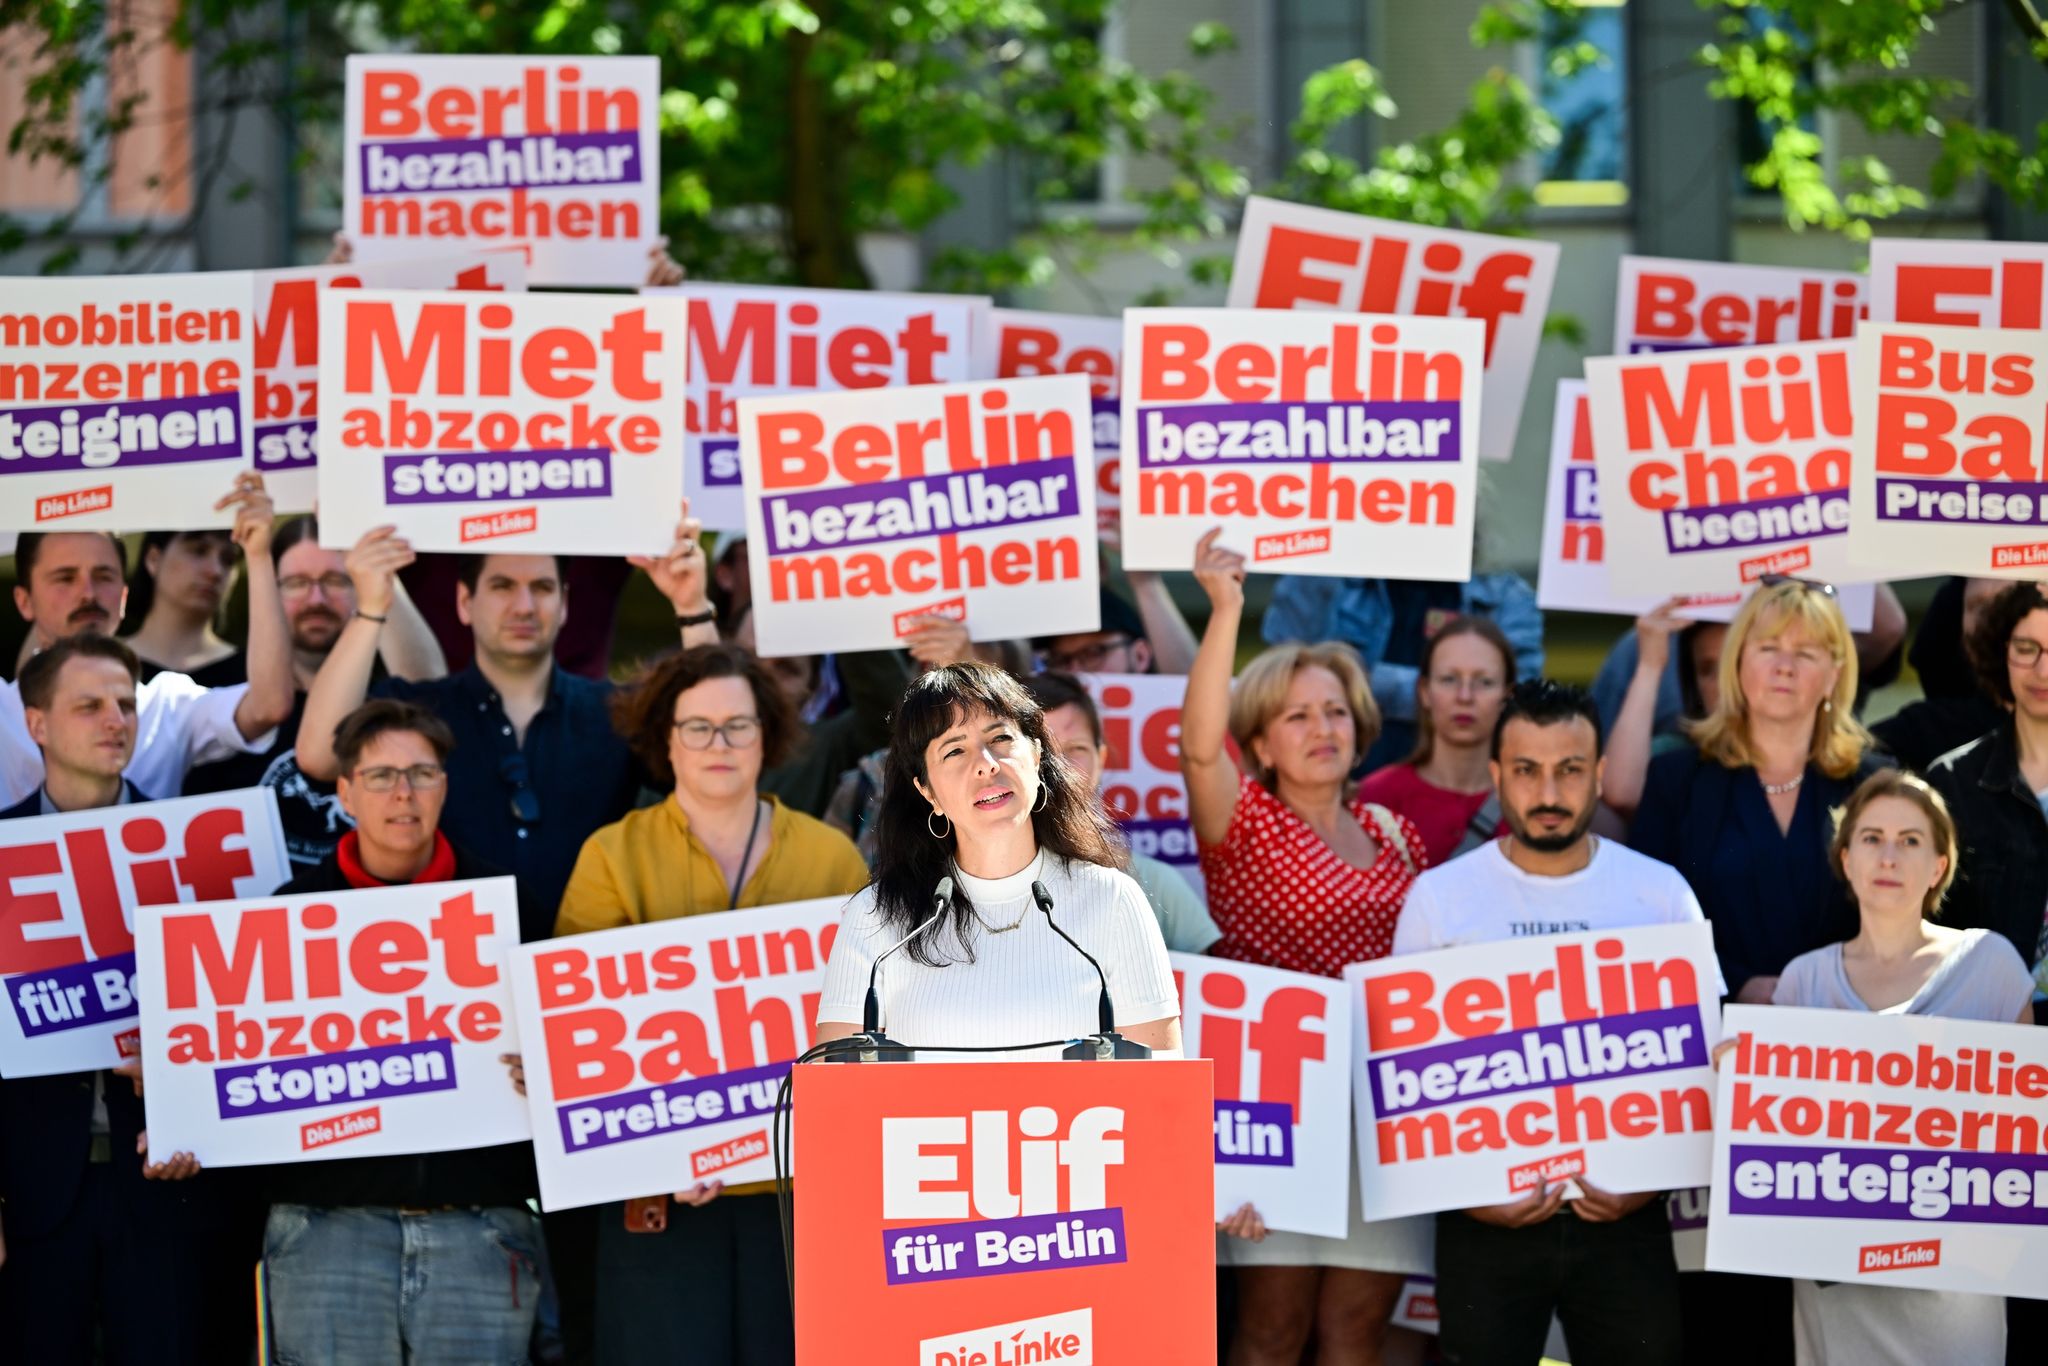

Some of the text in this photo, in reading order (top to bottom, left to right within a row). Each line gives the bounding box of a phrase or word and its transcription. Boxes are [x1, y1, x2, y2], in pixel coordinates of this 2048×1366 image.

[362, 66, 639, 138] Berlin
[367, 138, 633, 190] bezahlbar
[360, 189, 640, 239] machen
[0, 302, 241, 347] mobilien
[1255, 224, 1535, 371] Elif
[1634, 272, 1868, 345] Berli
[343, 301, 662, 401] Miet
[687, 298, 948, 388] Miet
[1140, 324, 1463, 403] Berlin
[1880, 334, 2035, 396] Bus
[0, 357, 240, 400] nzerne
[342, 399, 661, 455] abzocke
[757, 390, 1073, 490] Berlin
[1146, 406, 1450, 462] bezahlbar
[1875, 394, 2048, 482] Ba
[41, 488, 109, 518] Die Linke
[392, 456, 604, 497] stoppen
[1139, 462, 1456, 526] machen
[1885, 482, 2033, 522] Preise
[464, 508, 534, 538] Die Linke
[771, 470, 1067, 550] bezahlbar
[768, 532, 1080, 603] machen
[1259, 527, 1327, 557] Die Linke
[1997, 547, 2022, 566] Die
[0, 807, 255, 974] Elif
[162, 890, 500, 1010] Miet
[533, 942, 696, 1009] Bus
[18, 978, 86, 1027] für
[1365, 938, 1698, 1052] Berlin
[167, 996, 501, 1065] abzocke
[1173, 970, 1328, 1125] if
[225, 1049, 447, 1108] stoppen
[1377, 1023, 1692, 1111] bezahlbar
[306, 1112, 376, 1146] Die Linke
[567, 1086, 725, 1147] Preise
[1214, 1109, 1284, 1156] lin
[1377, 1085, 1713, 1166] machen
[1730, 1082, 2048, 1154] konzern
[695, 1136, 766, 1174] Die Linke
[882, 1106, 1125, 1220] Elif
[1513, 1167, 1539, 1189] Die
[893, 1219, 1116, 1276] für Berlin
[1865, 1243, 1935, 1269] Die Linke
[995, 1328, 1080, 1366] Linke
